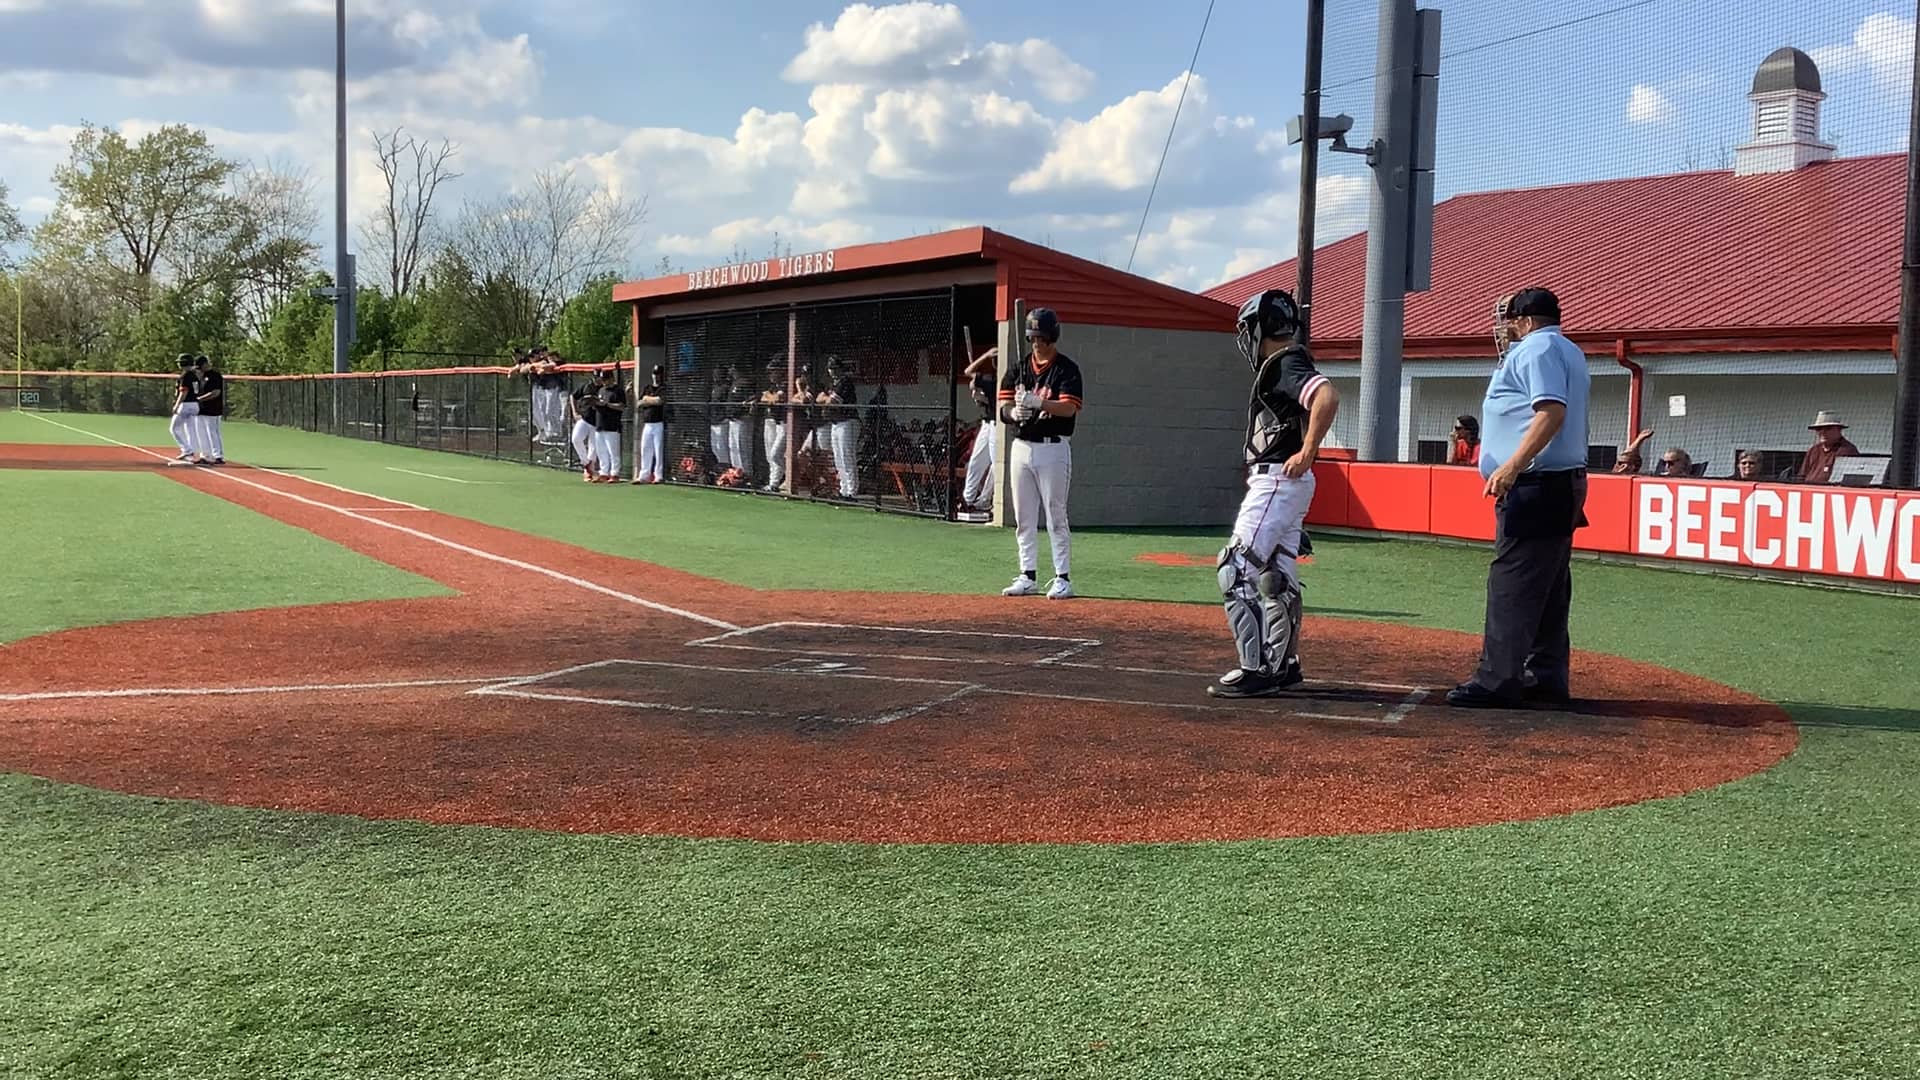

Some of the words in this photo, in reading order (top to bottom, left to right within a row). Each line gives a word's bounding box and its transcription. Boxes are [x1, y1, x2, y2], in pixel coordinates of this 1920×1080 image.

[688, 261, 769, 290] BEECHWOOD
[779, 251, 835, 278] TIGERS
[21, 391, 40, 404] 320
